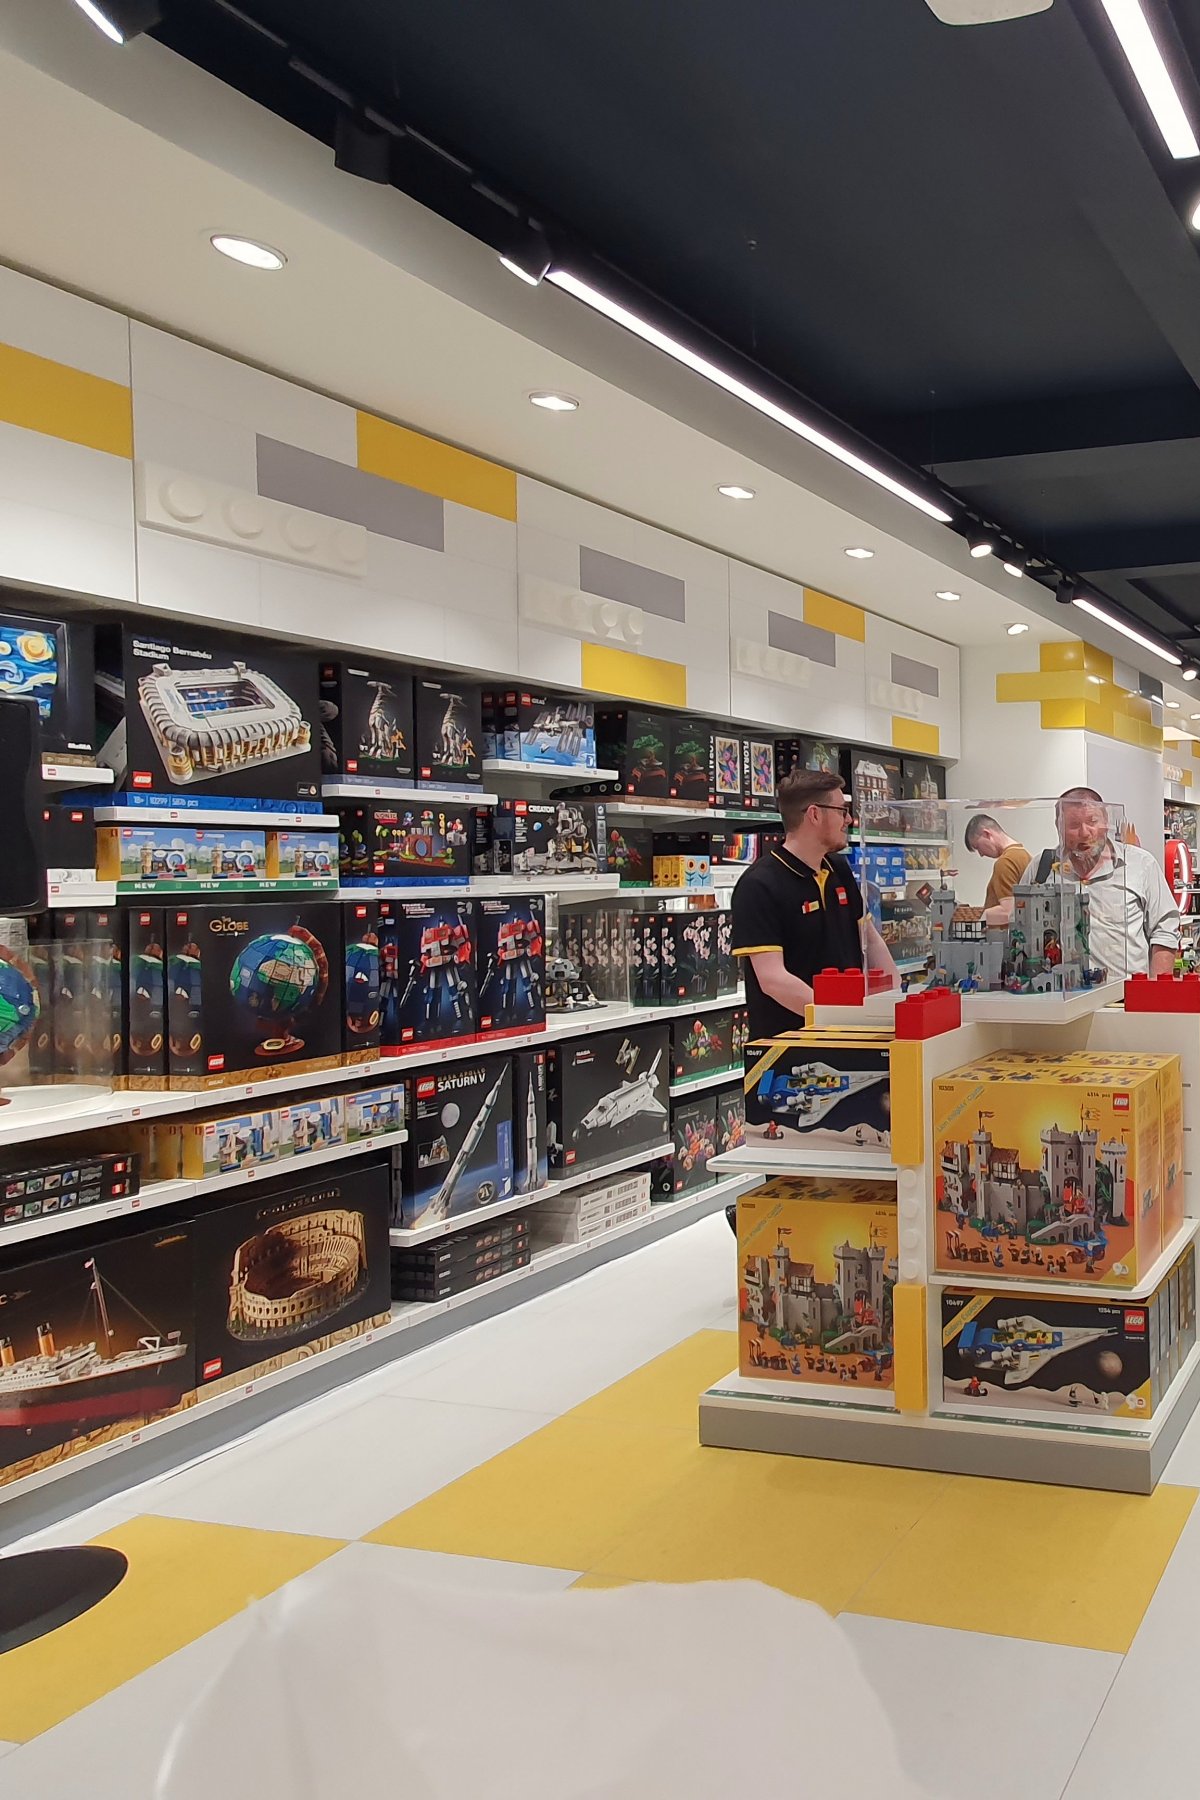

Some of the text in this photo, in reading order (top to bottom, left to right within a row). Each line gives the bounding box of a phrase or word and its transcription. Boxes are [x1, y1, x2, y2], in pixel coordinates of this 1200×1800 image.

[209, 918, 249, 933] GLOBE
[418, 1072, 486, 1093] LEGO SATURN V
[945, 1299, 964, 1307] 10497
[1124, 1315, 1145, 1327] LEGO
